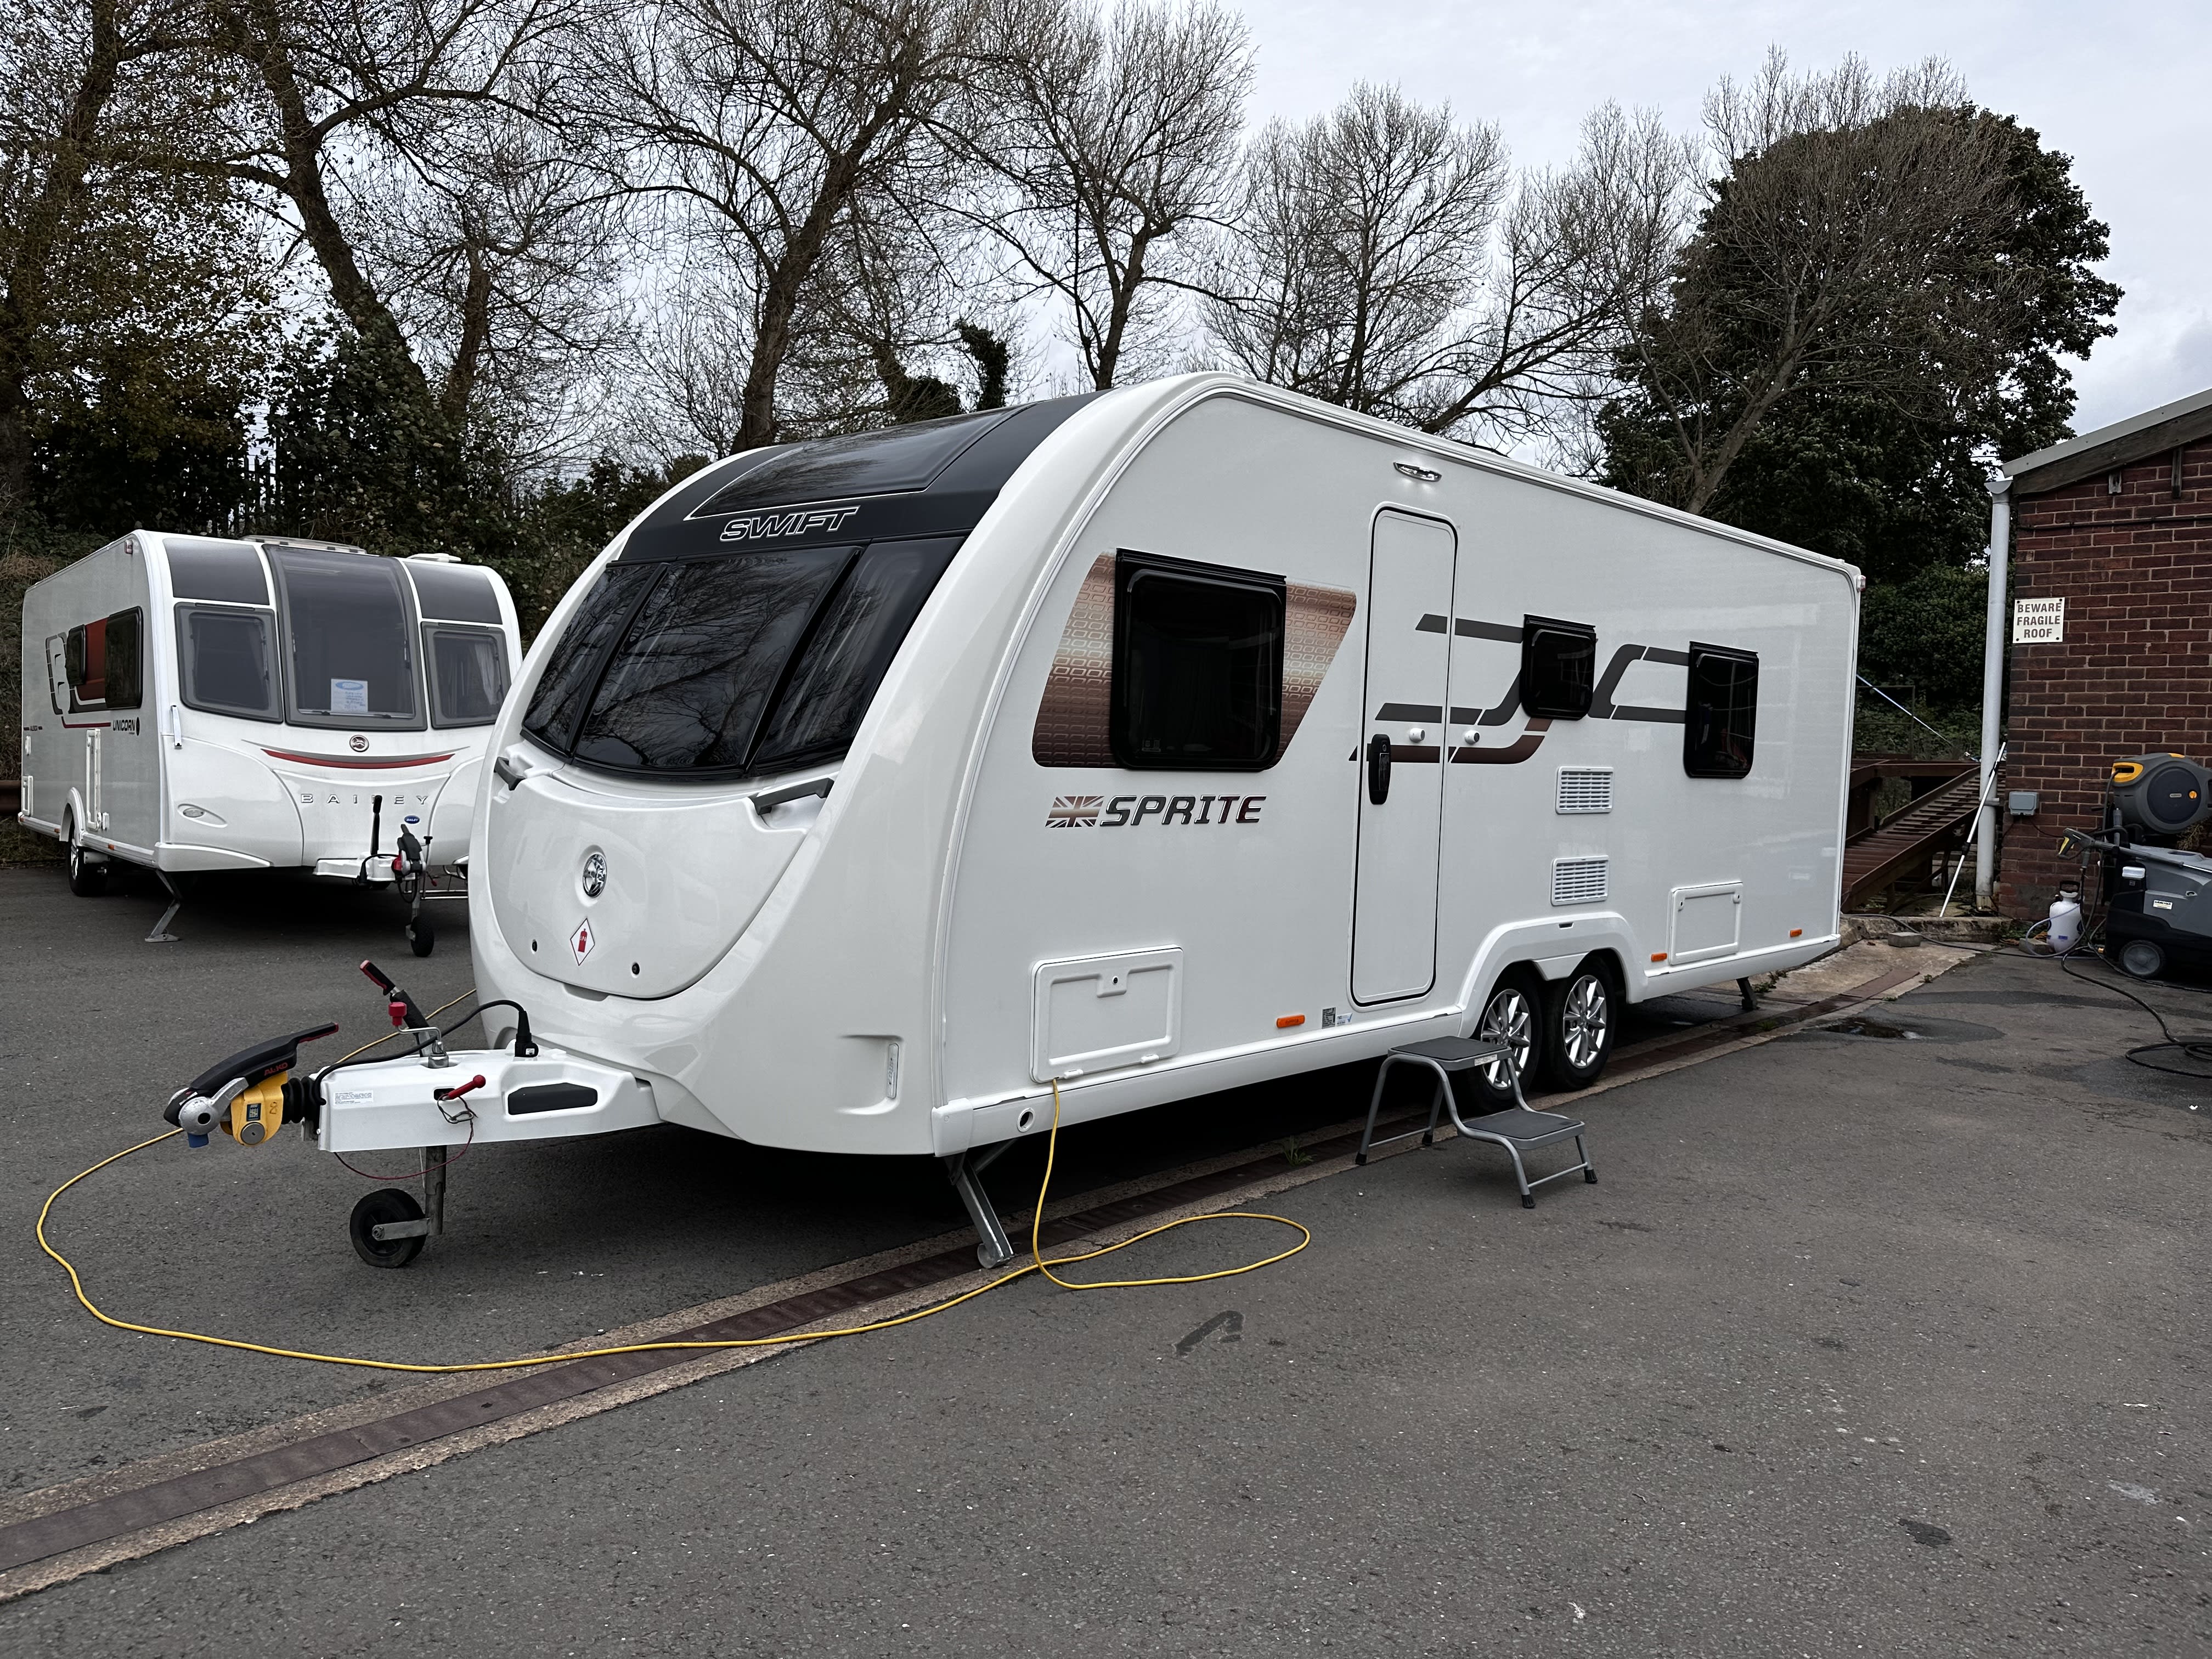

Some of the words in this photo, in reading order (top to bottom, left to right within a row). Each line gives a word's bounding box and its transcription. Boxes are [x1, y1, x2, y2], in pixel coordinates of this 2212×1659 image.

[720, 505, 860, 542] SWIFT
[2018, 602, 2062, 613] BEWARE
[2017, 616, 2060, 625] FRAGILE
[2024, 629, 2052, 638] ROOF
[113, 719, 136, 731] UNICORN
[1099, 795, 1267, 826] SPRITE
